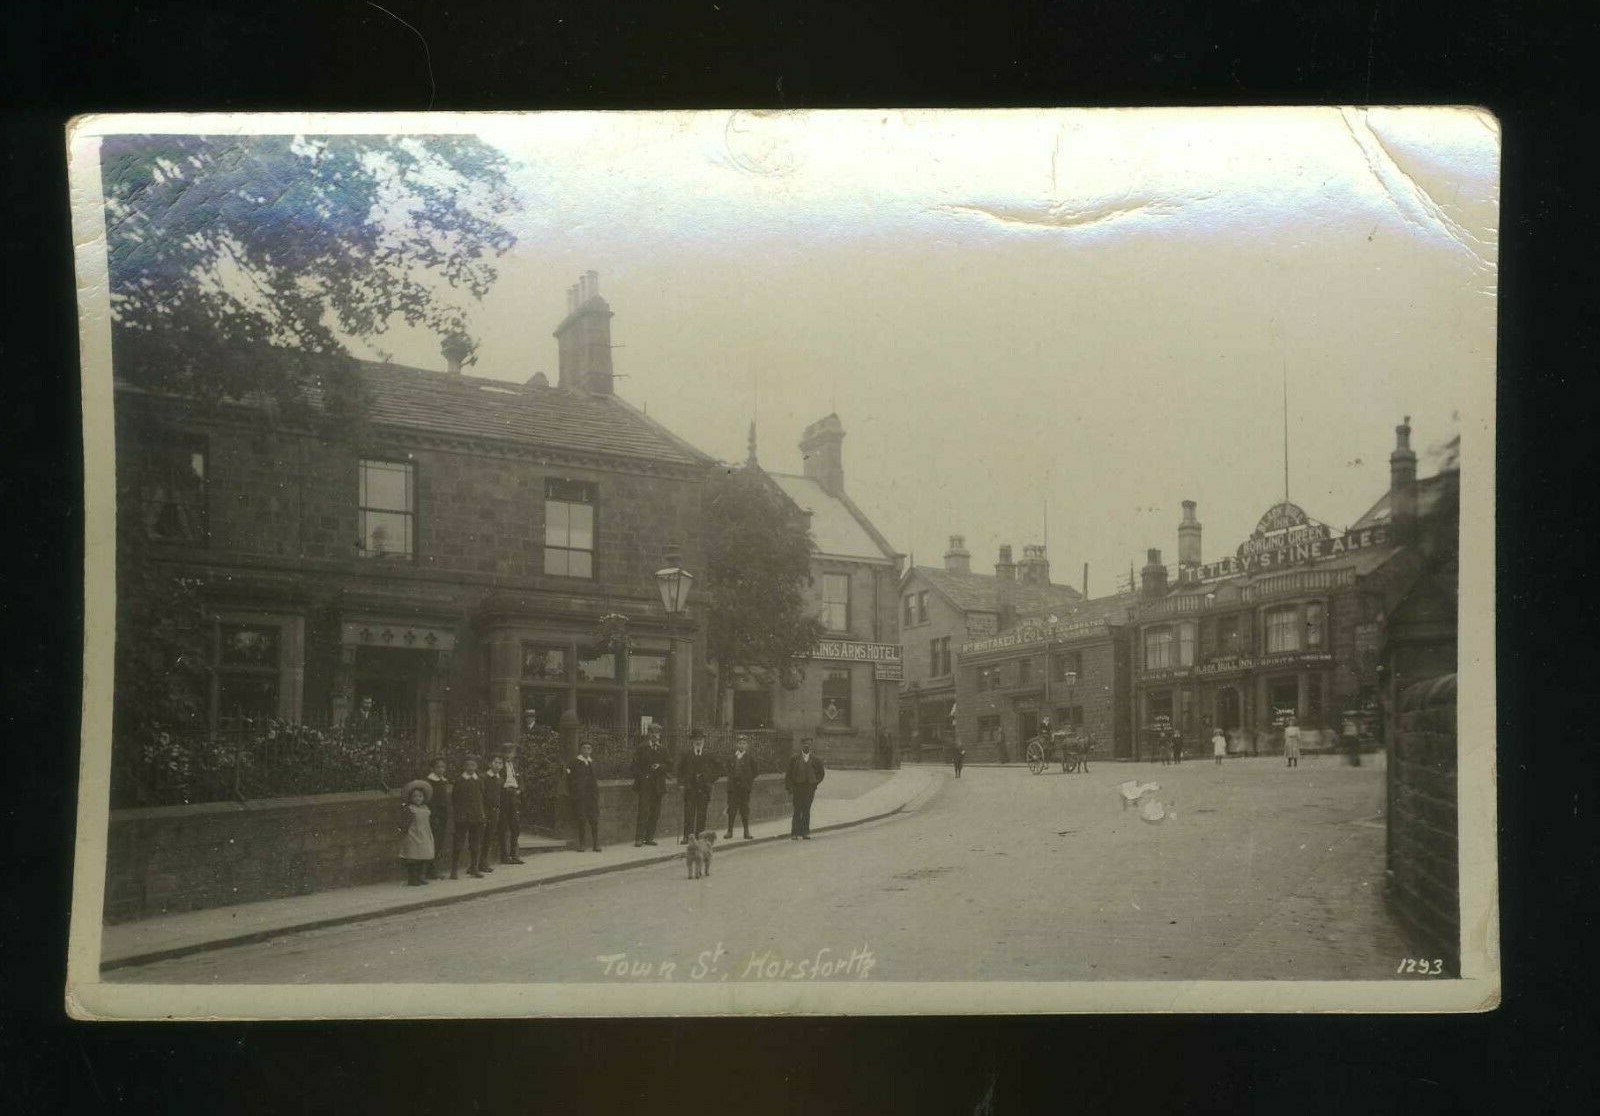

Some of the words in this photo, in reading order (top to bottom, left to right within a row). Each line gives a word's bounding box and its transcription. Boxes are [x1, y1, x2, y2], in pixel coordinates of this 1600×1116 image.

[1243, 534, 1284, 555] BOWLING
[1288, 525, 1323, 546] GREEN
[1186, 553, 1271, 582] TETLEY'S
[1277, 543, 1322, 566] FINE
[1332, 529, 1386, 553] ALES
[841, 643, 866, 659] ARMS
[867, 644, 899, 660] HOTEL
